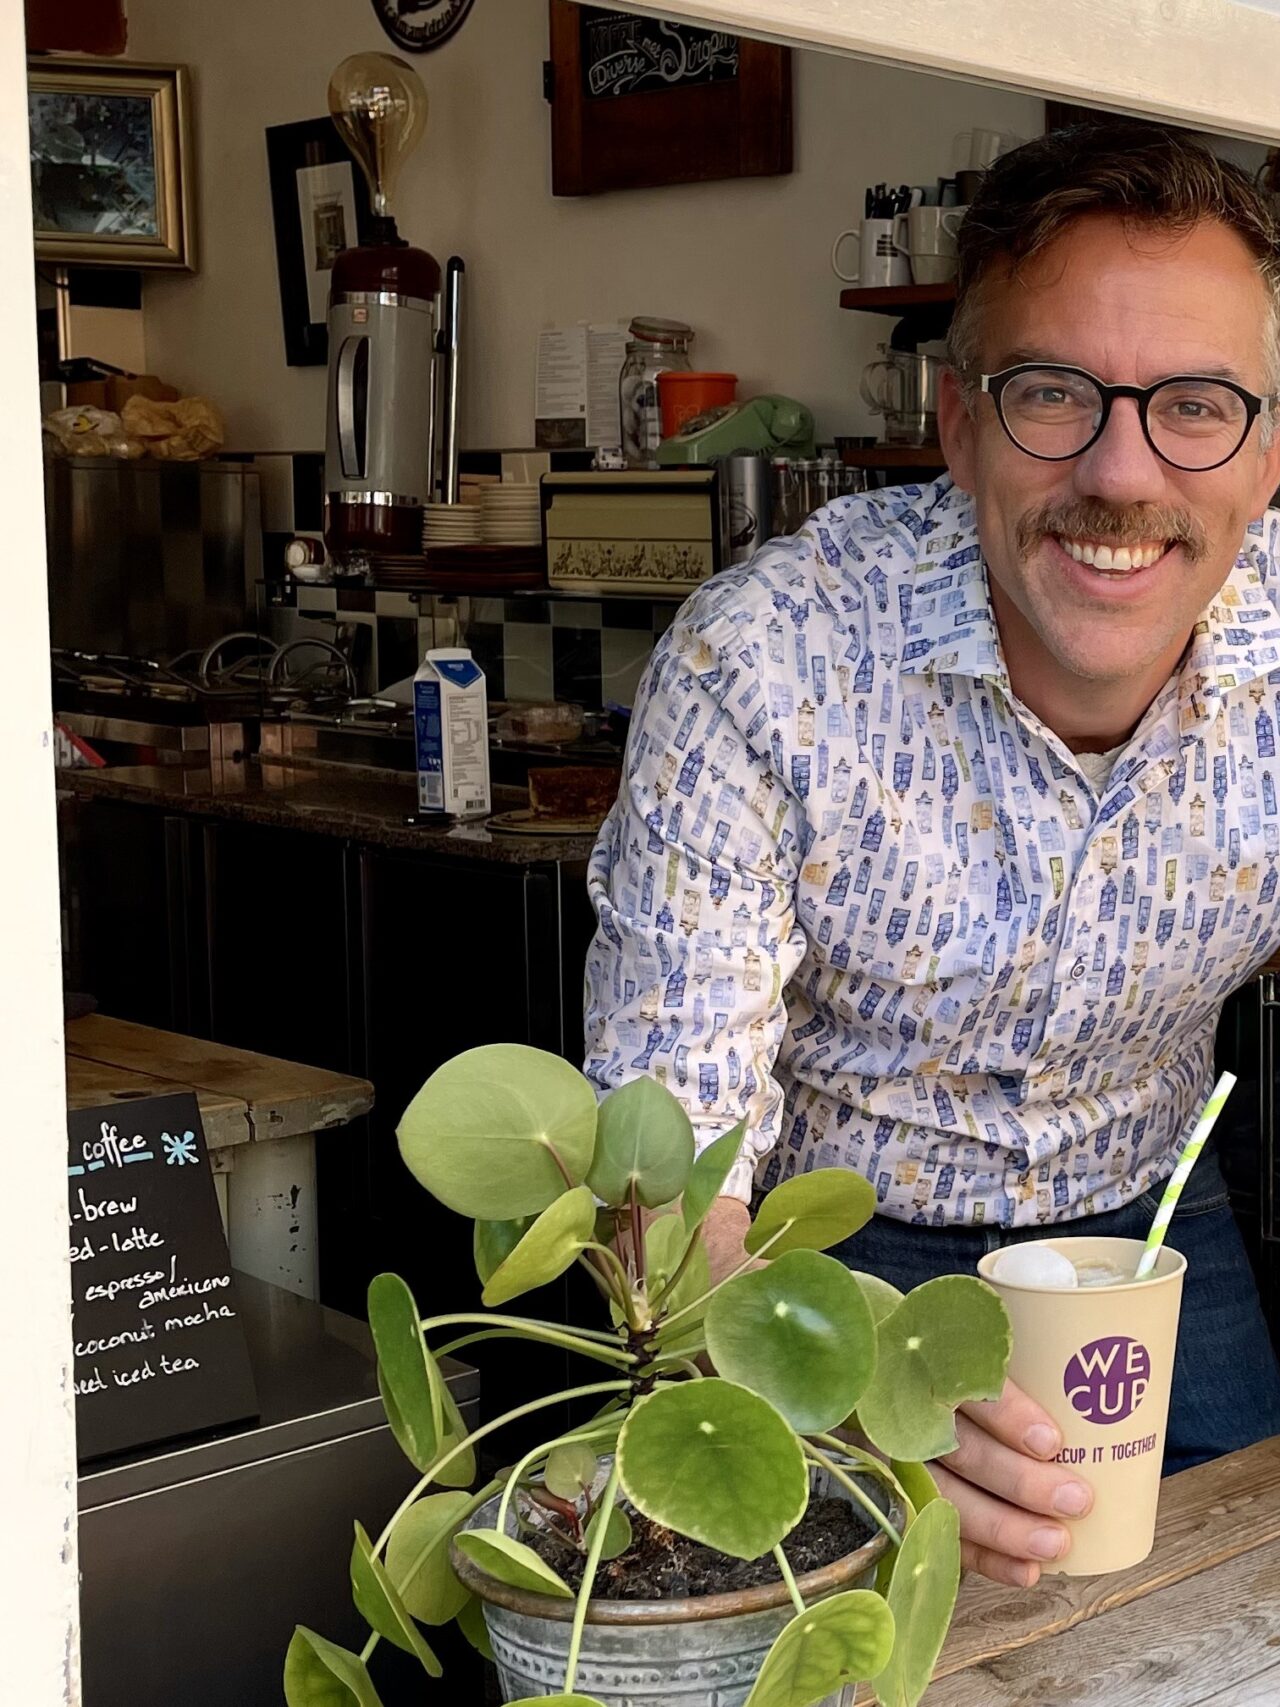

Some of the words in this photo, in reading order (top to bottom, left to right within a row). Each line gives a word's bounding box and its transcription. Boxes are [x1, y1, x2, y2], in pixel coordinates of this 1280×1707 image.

[596, 56, 646, 87] Diverse
[82, 1121, 147, 1168] coffee
[69, 1187, 137, 1226] -brew
[138, 1276, 231, 1309] americano
[164, 1302, 237, 1331] mocha
[112, 1360, 156, 1387] iced
[159, 1354, 200, 1375] tea
[1074, 1340, 1145, 1379] WE
[1066, 1377, 1149, 1417] CUP
[1050, 1447, 1086, 1464] ECUP
[1092, 1446, 1105, 1463] IT
[1110, 1433, 1157, 1462] TOGETHER
